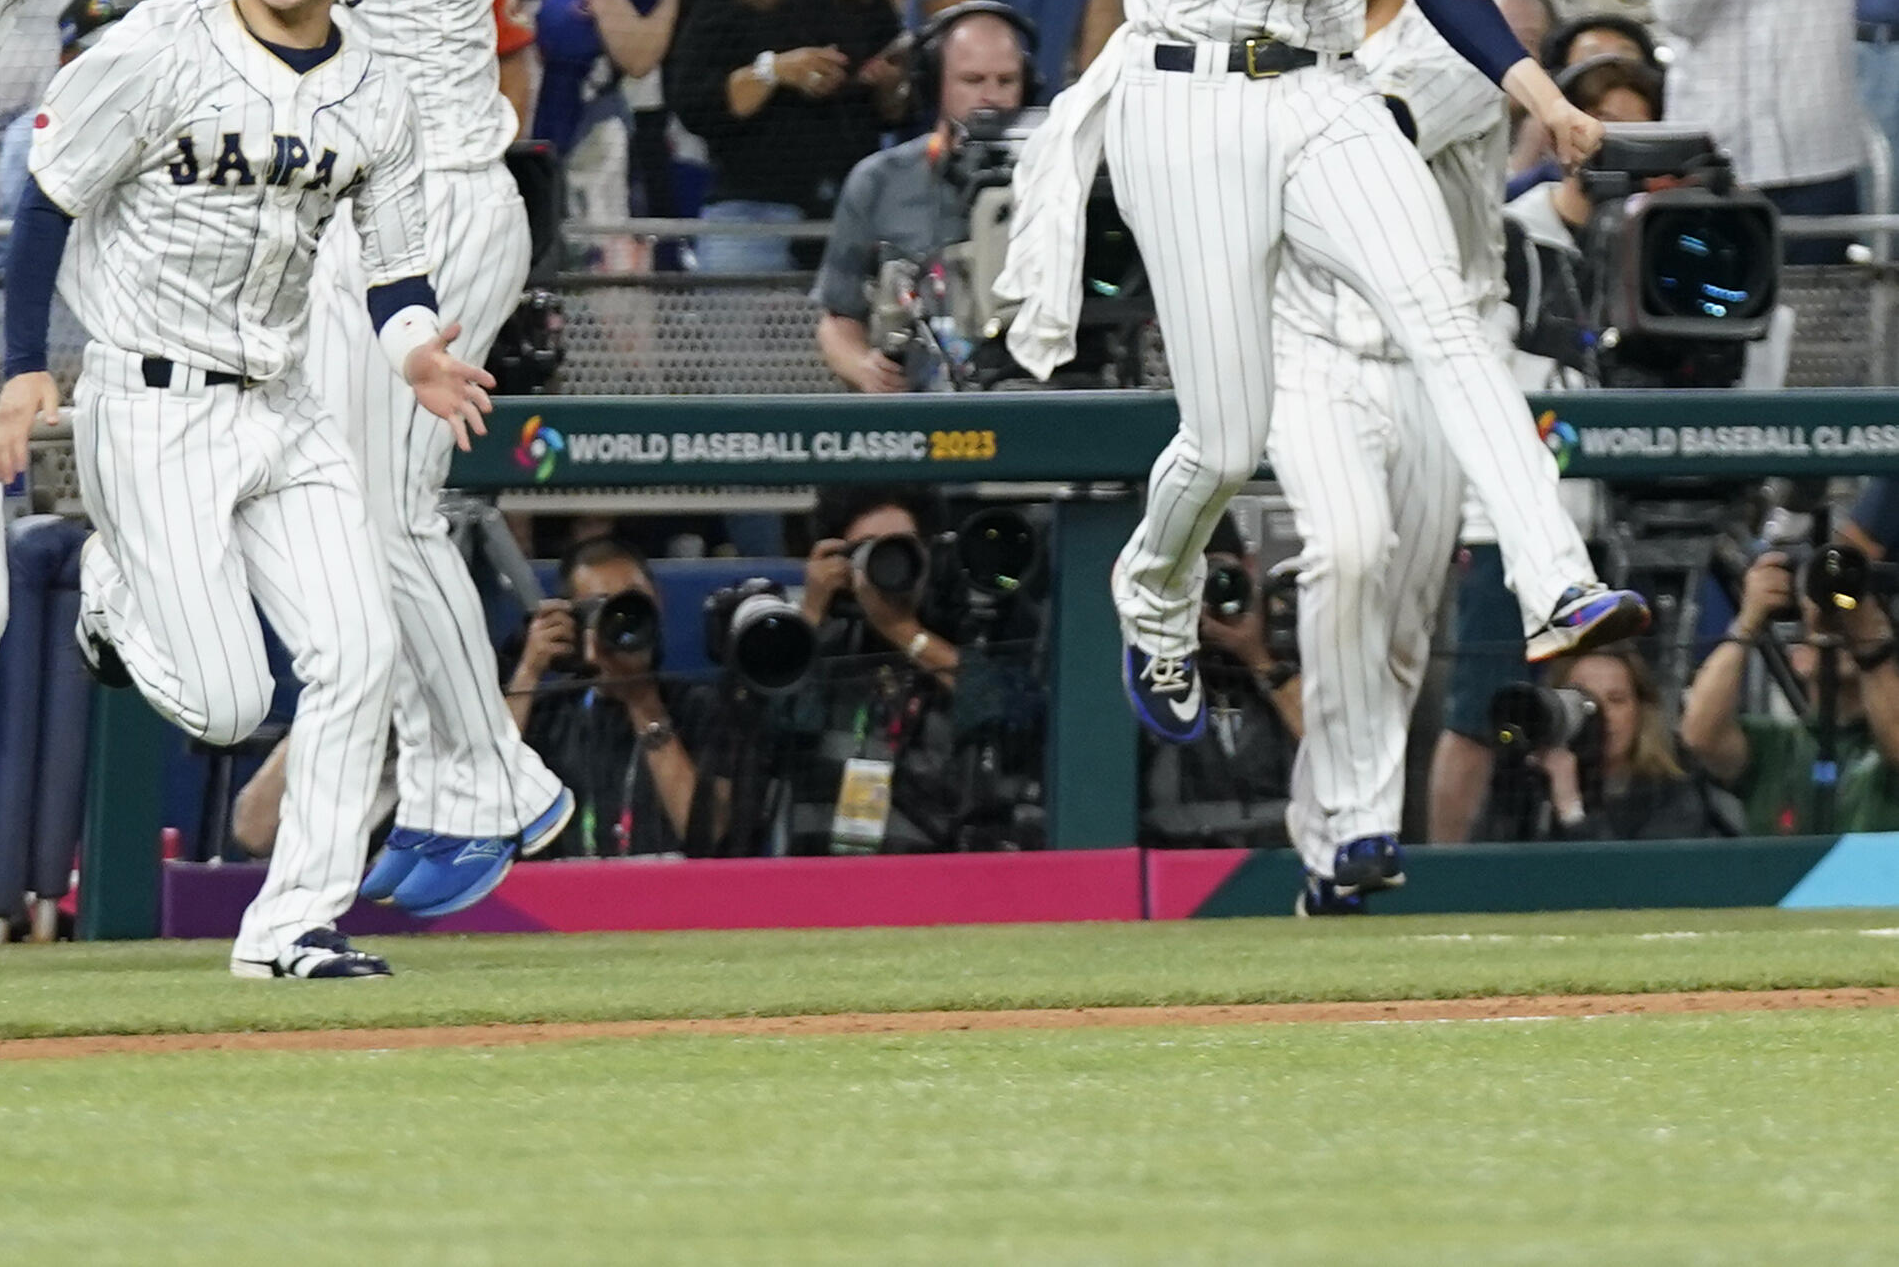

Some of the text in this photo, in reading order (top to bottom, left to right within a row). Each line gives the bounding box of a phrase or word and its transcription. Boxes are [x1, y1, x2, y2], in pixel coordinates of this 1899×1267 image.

[568, 429, 997, 462] WORLD BASEBALL CLASSIC 2023
[1580, 427, 1679, 456] WORLD
[1680, 426, 1812, 456] BASEBALL
